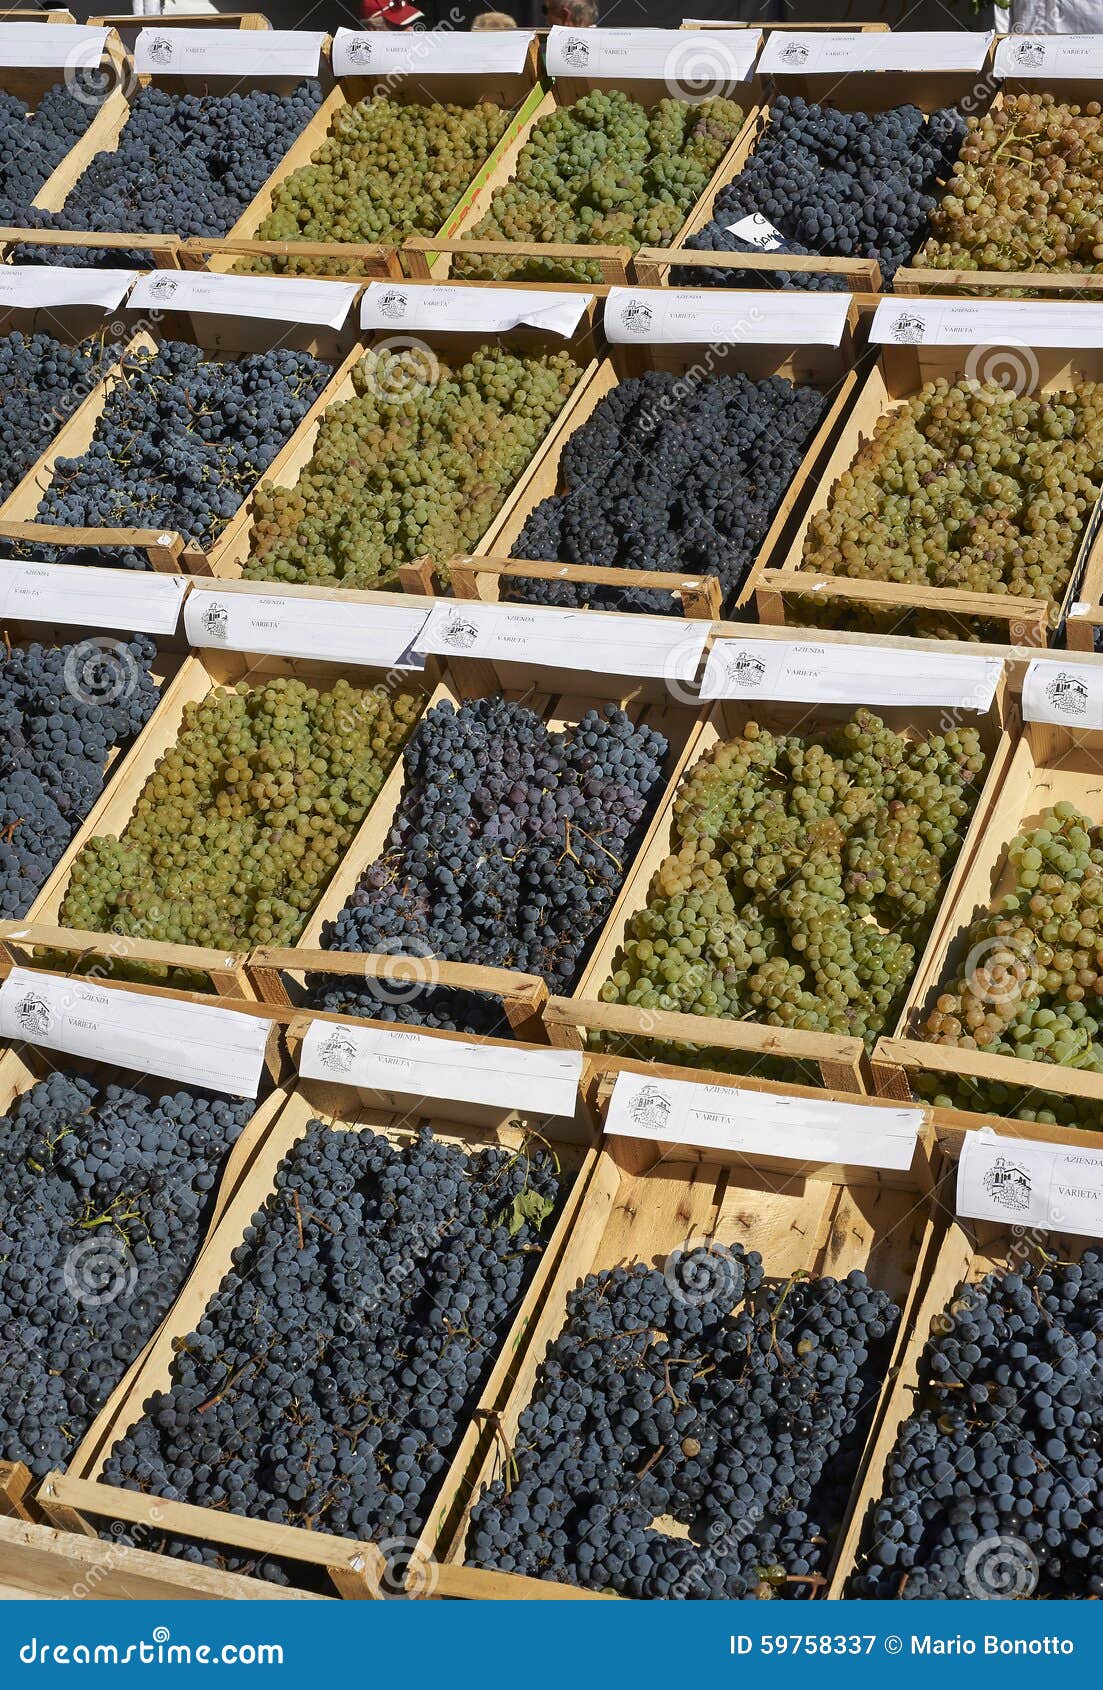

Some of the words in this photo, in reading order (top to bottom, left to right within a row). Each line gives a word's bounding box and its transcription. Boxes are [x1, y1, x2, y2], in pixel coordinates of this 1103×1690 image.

[251, 620, 280, 629] VARIETA'
[506, 615, 535, 624] AZIENDA
[793, 647, 824, 655] AZIENDA
[787, 669, 820, 678] VARIETA'
[80, 993, 109, 1005] AZIENDA
[68, 1018, 100, 1031] VARIETA'
[390, 1032, 421, 1042] AZIENDA
[379, 1056, 413, 1067] VARIETA'
[704, 1086, 740, 1097] AZIENDA
[695, 1113, 735, 1124] VARIETA'
[1064, 1156, 1103, 1167] AZIENDA
[1058, 1186, 1102, 1199] VARIETA'
